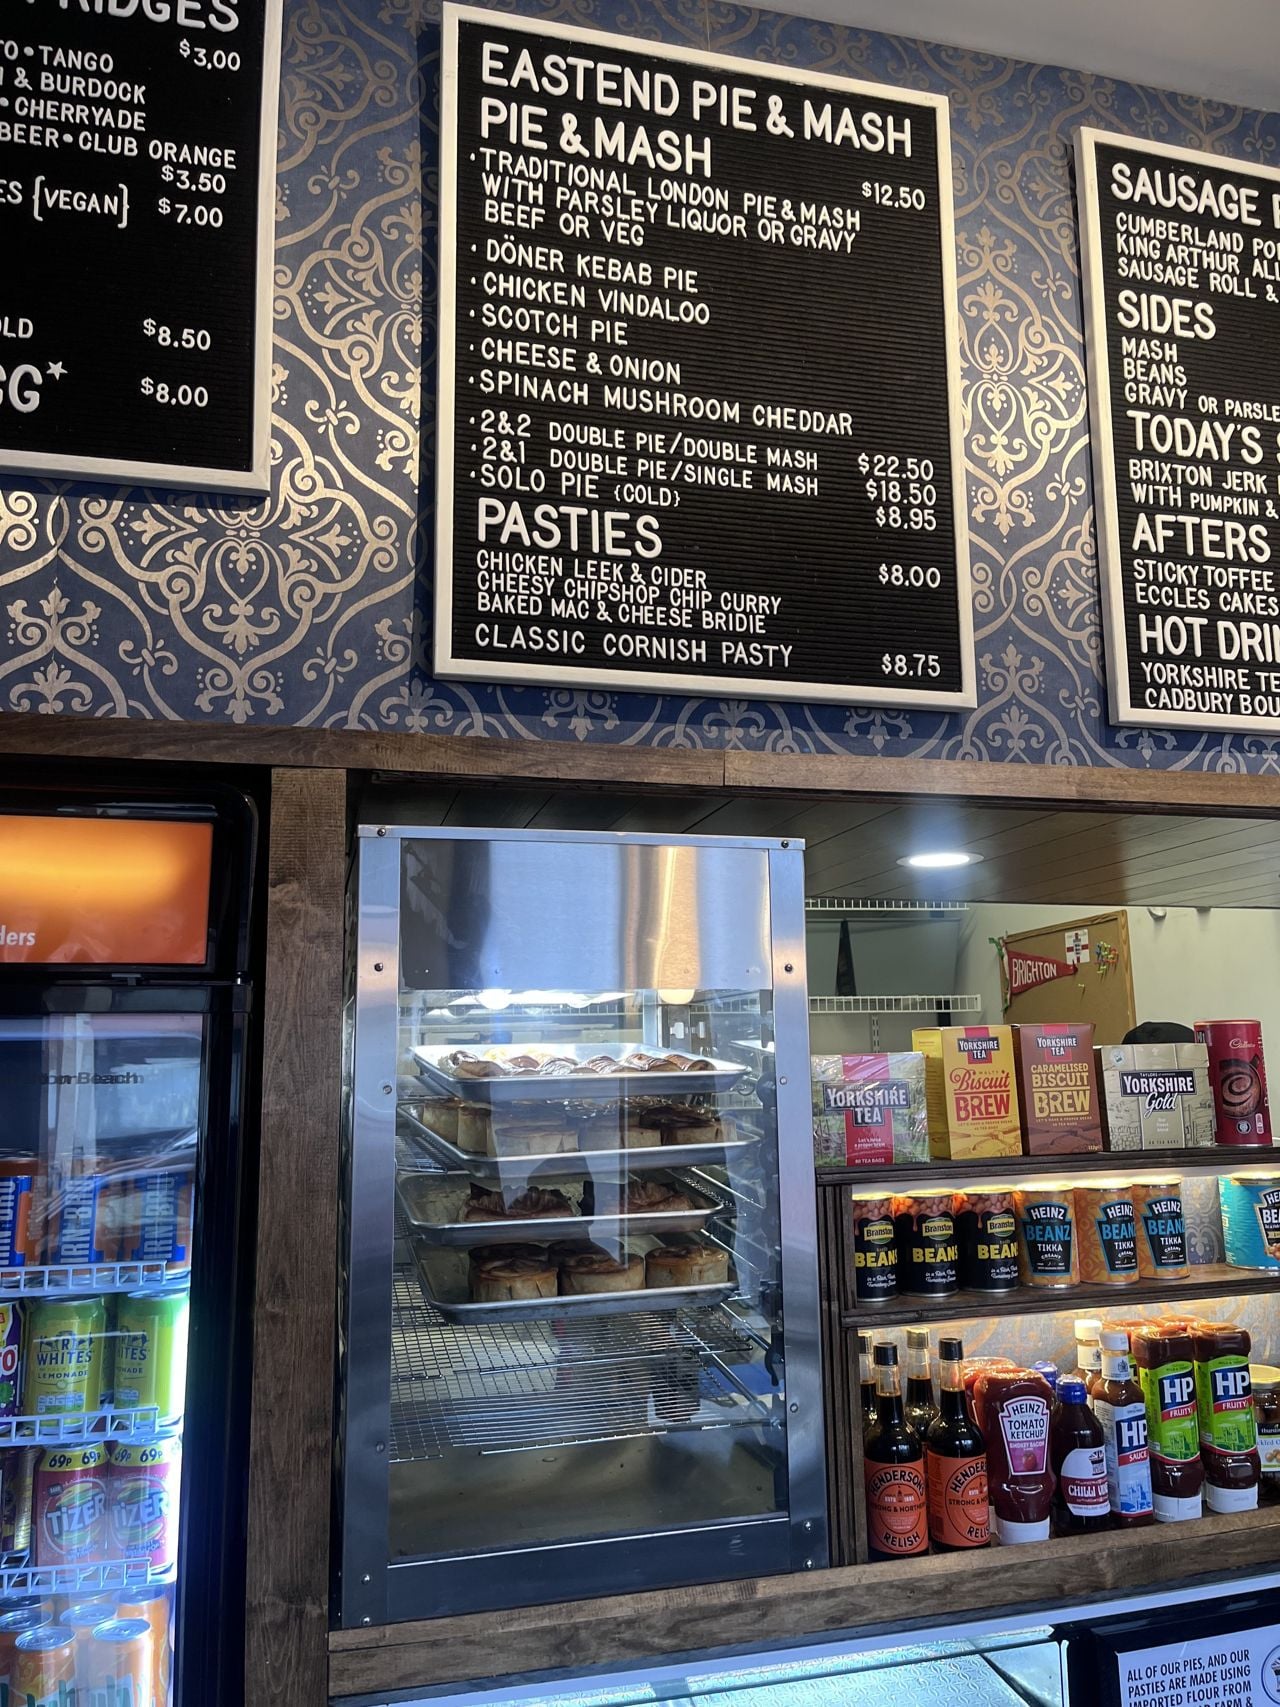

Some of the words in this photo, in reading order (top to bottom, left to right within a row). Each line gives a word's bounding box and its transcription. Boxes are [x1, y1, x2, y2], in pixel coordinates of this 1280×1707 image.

[38, 45, 114, 73] TANGO
[40, 71, 147, 105] BURDOCK
[481, 41, 681, 118] EASTEND
[692, 80, 758, 132] PIE
[765, 94, 795, 139] &
[803, 99, 912, 158] MASH
[14, 97, 147, 132] CHERRYADE
[480, 96, 548, 151] PIE
[78, 131, 138, 157] CLUB
[148, 139, 237, 170] ORANGE
[160, 164, 227, 195] $3.50
[479, 146, 637, 197] TRADITIONAL
[647, 176, 729, 212] LONDON
[1110, 162, 1263, 227] SAUSAGE
[861, 180, 926, 211] $12.50
[157, 196, 224, 229] $7.00
[481, 171, 544, 206] WITH
[555, 185, 659, 224] PARSLEY
[666, 203, 748, 239] LIQUOR
[757, 217, 785, 245] OR
[789, 224, 856, 254] GRAVY
[484, 198, 546, 231] BEEF
[559, 212, 591, 240] OR
[600, 219, 645, 247] VEG
[1115, 211, 1245, 254] CUMBERLAND
[486, 233, 565, 273] DÖNER
[576, 252, 653, 286] KEBAB
[663, 265, 699, 294] PIE
[1116, 232, 1162, 260] KING
[1165, 243, 1241, 276] ARTHUR
[1117, 255, 1200, 290] SAUSAGE
[1208, 271, 1258, 299] ROLL
[482, 270, 586, 309] CHICKEN
[598, 288, 711, 325] VINDALOO
[480, 302, 579, 340] SCOTCH
[590, 318, 629, 346] PIE
[1116, 289, 1217, 341] SIDES
[142, 317, 212, 351] $8.50
[1120, 335, 1178, 364] MASH
[480, 336, 578, 372] CHEESE
[585, 351, 603, 376] &
[608, 353, 682, 386] ONION
[1122, 357, 1188, 387] BEANS
[478, 367, 590, 406] SPINACH
[603, 384, 741, 425] MUSHROOM
[751, 403, 854, 437] CHEDDAR
[1124, 381, 1188, 410] GRAVY
[480, 408, 532, 438] 2&2
[548, 420, 627, 450] DOUBLE
[766, 446, 819, 472] MASH
[1125, 409, 1264, 465] TODAY'S
[479, 462, 546, 494] SOLO
[560, 471, 600, 499] PIE
[481, 435, 526, 465] 2&1
[549, 447, 629, 477] DOUBLE
[766, 472, 819, 497] MASH
[857, 451, 934, 482] $22.50
[1128, 458, 1213, 488] BRIXTON
[1221, 470, 1268, 495] JERK
[864, 477, 937, 507] $18.50
[1130, 481, 1183, 508] WITH
[1189, 492, 1260, 517] PUMPKIN
[477, 496, 664, 559] PASTIES
[1131, 512, 1272, 564] AFTERS
[476, 548, 563, 578] CHICKEN
[573, 557, 624, 583] LEEK
[650, 565, 708, 590] CIDER
[1132, 558, 1199, 587] STICKY
[1202, 564, 1276, 593] TOFFEE
[476, 570, 556, 597] CHEESY
[563, 577, 661, 606] CHIPSHOP
[669, 586, 714, 611] CHIP
[719, 591, 782, 616] CURRY
[1135, 582, 1211, 611] ECCLES
[1218, 591, 1280, 617] CAKES
[476, 590, 543, 617] BAKED
[550, 597, 590, 621] MAC
[617, 603, 693, 629] CHEESE
[701, 610, 767, 635] BRIDIE
[474, 622, 586, 655] CLASSIC
[602, 632, 708, 664] CORNISH
[720, 640, 794, 668] PASTY
[1138, 613, 1209, 658] HOT
[880, 652, 942, 678] $8.75
[1140, 661, 1251, 691] YORKSHIRE
[1144, 687, 1234, 714] CADBURY
[1012, 958, 1057, 988] BRIGHTON
[959, 1039, 999, 1051] YORKSHIRE
[972, 1050, 987, 1059] TEA
[1036, 1037, 1077, 1048] YORKSHIRE
[1050, 1047, 1065, 1056] TEA
[1030, 1062, 1089, 1073] CARAMELISED
[1031, 1072, 1089, 1088] BISCUIT
[826, 1086, 907, 1108] YORKSHIRE
[1123, 1075, 1194, 1094] YORKSHIRE
[854, 1106, 882, 1124] TEA
[954, 1093, 1011, 1122] BREW
[1033, 1090, 1091, 1118] BREW
[1143, 1092, 1178, 1119] Gold
[1030, 1206, 1065, 1220] HEINZ
[1151, 1200, 1181, 1215] HEINZ
[1026, 1224, 1071, 1242] BEANZ
[1037, 1243, 1063, 1252] TIKKA
[1160, 1236, 1182, 1246] TIKKA
[36, 1350, 92, 1366] WHITES
[1162, 1376, 1194, 1404] HP
[1214, 1371, 1250, 1396] HP
[1007, 1418, 1045, 1430] TOMATO
[1011, 1403, 1041, 1416] HEINZ
[1010, 1429, 1045, 1440] KETCHUP
[1120, 1419, 1148, 1448] HP
[1128, 1450, 1148, 1462] SAUCE
[1068, 1484, 1096, 1498] CHILLI
[883, 1531, 921, 1548] RELISH
[1127, 1668, 1143, 1683] ALL
[1145, 1665, 1158, 1679] OF
[1160, 1661, 1181, 1677] OUR
[1183, 1657, 1206, 1674] PIES,
[1207, 1653, 1228, 1668] AND
[1229, 1648, 1250, 1664] OUR
[1128, 1683, 1166, 1699] PASTIES
[1168, 1676, 1187, 1690] ARE
[1189, 1671, 1218, 1687] MADE
[1220, 1664, 1251, 1681] USING
[1186, 1685, 1220, 1704] FLOUR
[1223, 1680, 1252, 1695] FROM
